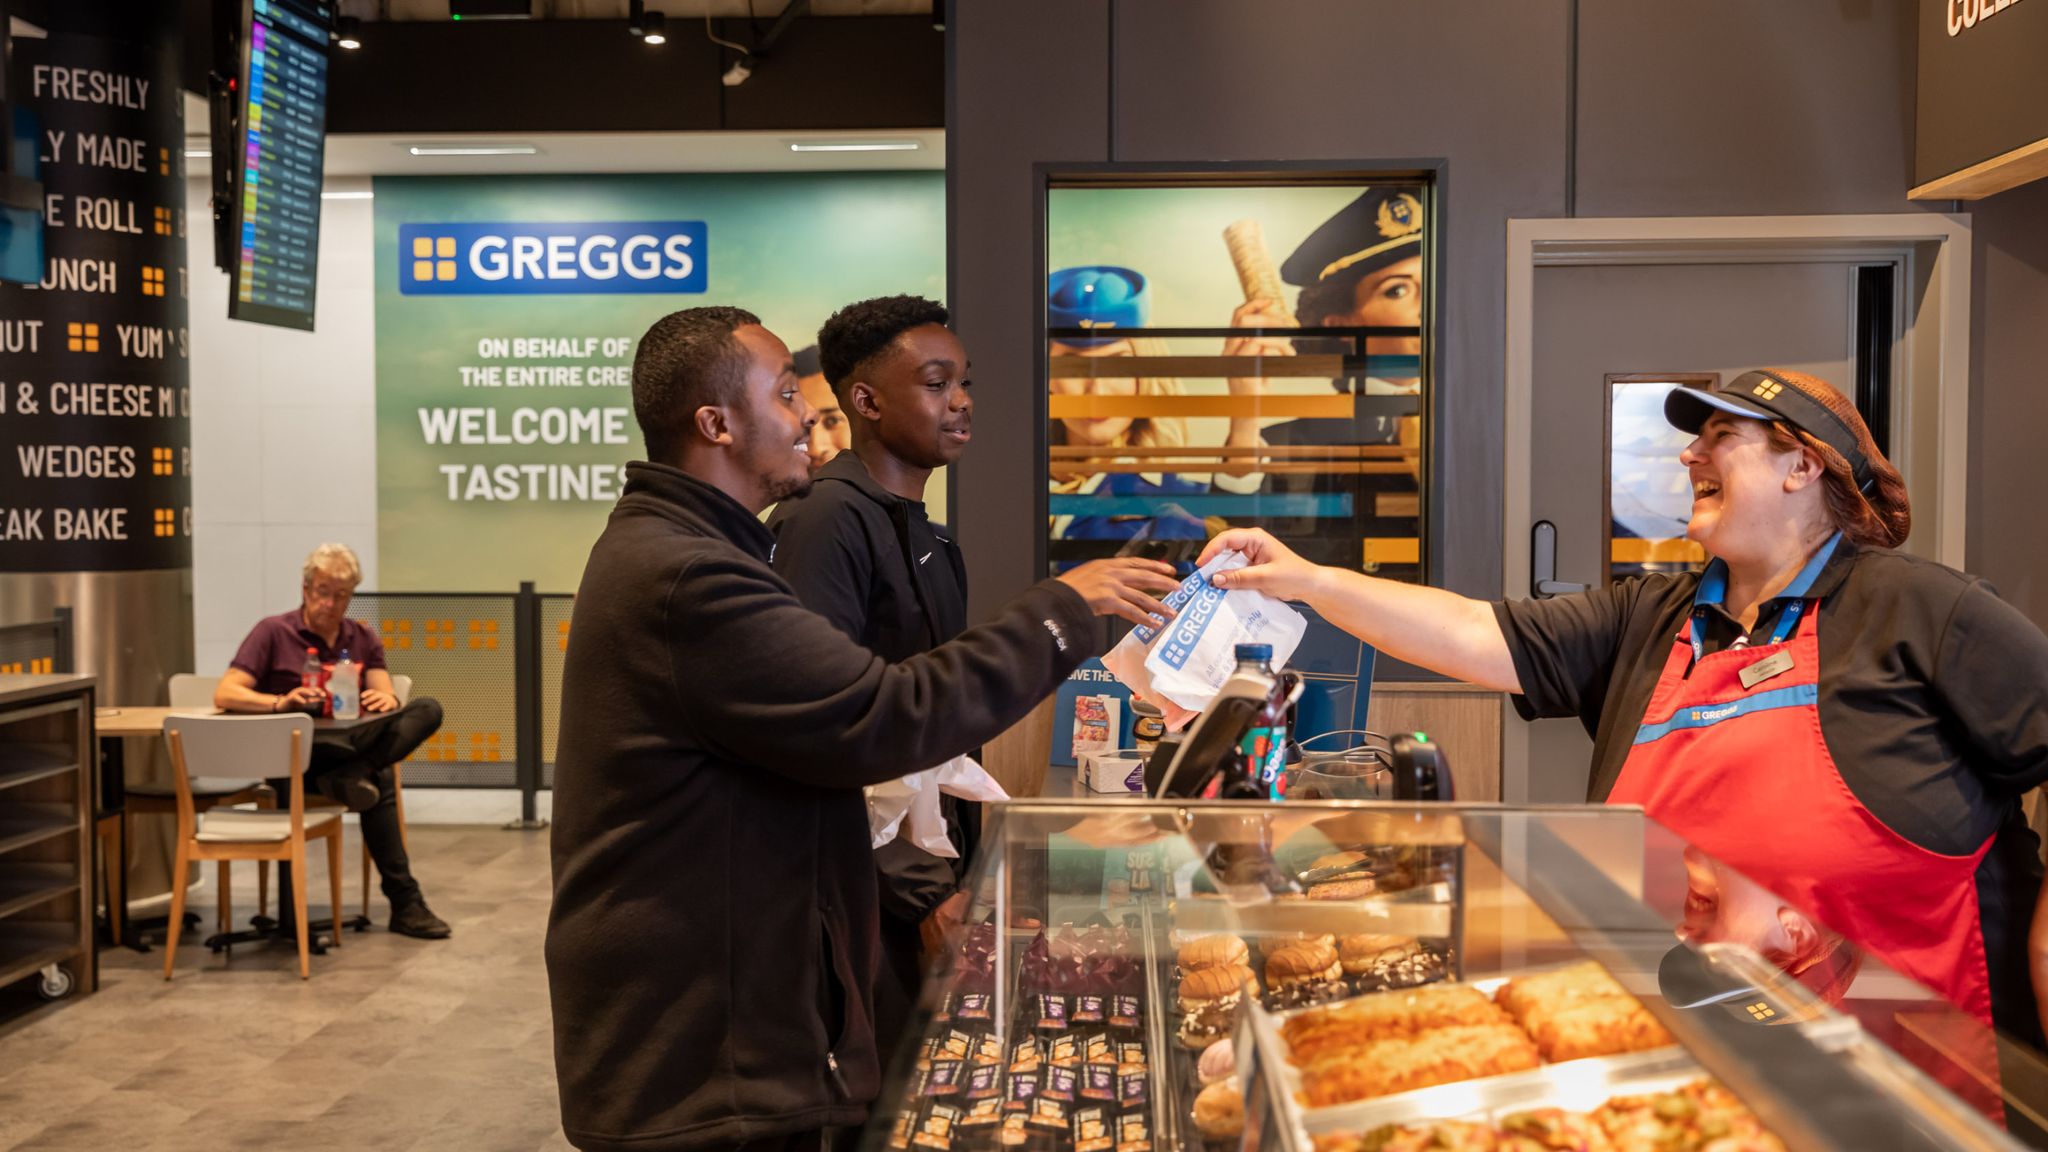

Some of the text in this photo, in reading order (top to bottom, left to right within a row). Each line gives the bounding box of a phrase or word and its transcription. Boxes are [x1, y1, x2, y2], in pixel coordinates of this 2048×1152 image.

[33, 64, 149, 110] FRESHLY
[40, 129, 65, 162] Y
[77, 131, 147, 173] MADE
[76, 195, 143, 235] ROLL
[23, 257, 116, 294] UNCH
[469, 234, 694, 281] GREGGS
[478, 337, 632, 358] ON BEHALF OF
[459, 366, 632, 387] THE ENTIRE CRE
[16, 381, 39, 415] &
[50, 381, 153, 418] CHEESE
[418, 407, 629, 445] WELCOME
[17, 445, 136, 478] WEDGES
[54, 508, 128, 541] BAKE
[1177, 584, 1223, 646] GREGG
[1092, 668, 1113, 682] THE
